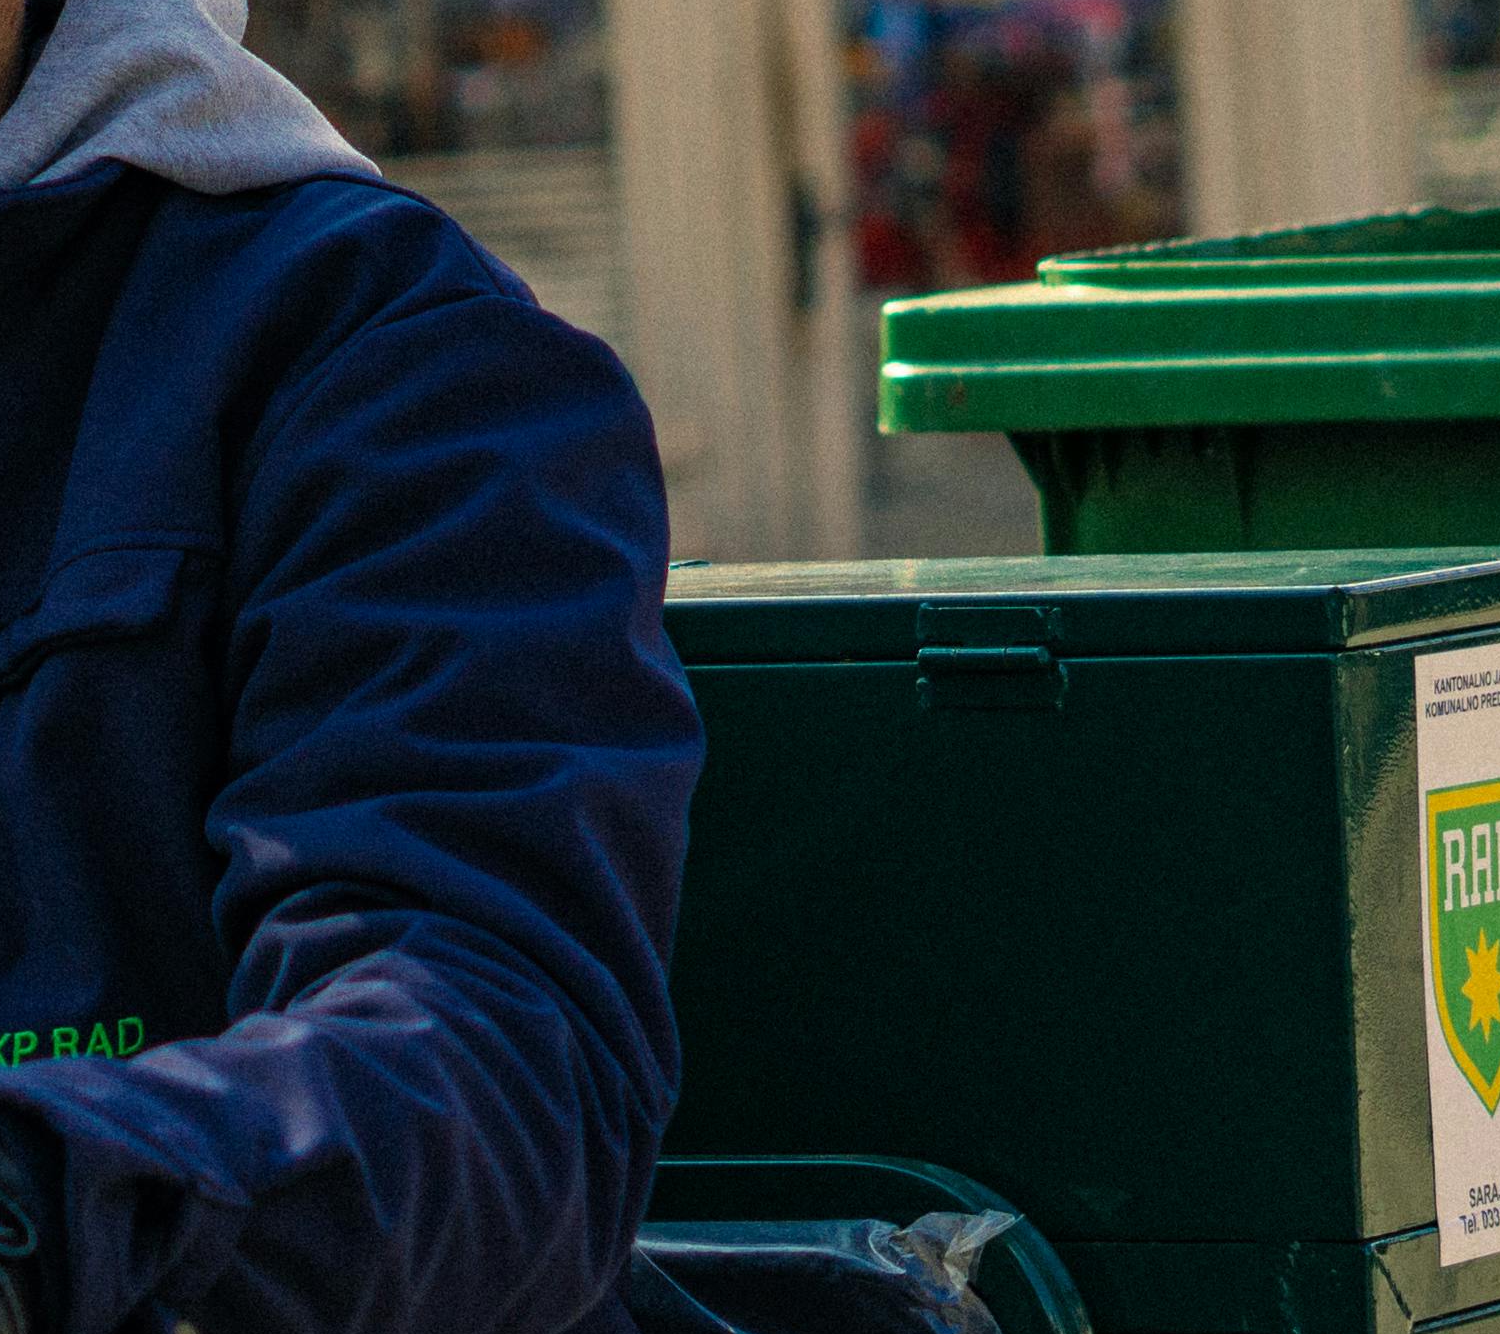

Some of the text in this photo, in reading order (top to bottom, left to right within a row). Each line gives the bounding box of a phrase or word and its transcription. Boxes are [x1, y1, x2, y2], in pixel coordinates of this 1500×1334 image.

[1433, 671, 1492, 695] KANTONALNO
[1425, 695, 1479, 719] KOMUNALNO
[53, 1017, 144, 1060] RAD
[1459, 1213, 1480, 1235] Tel.
[1481, 1207, 1500, 1229] 033
